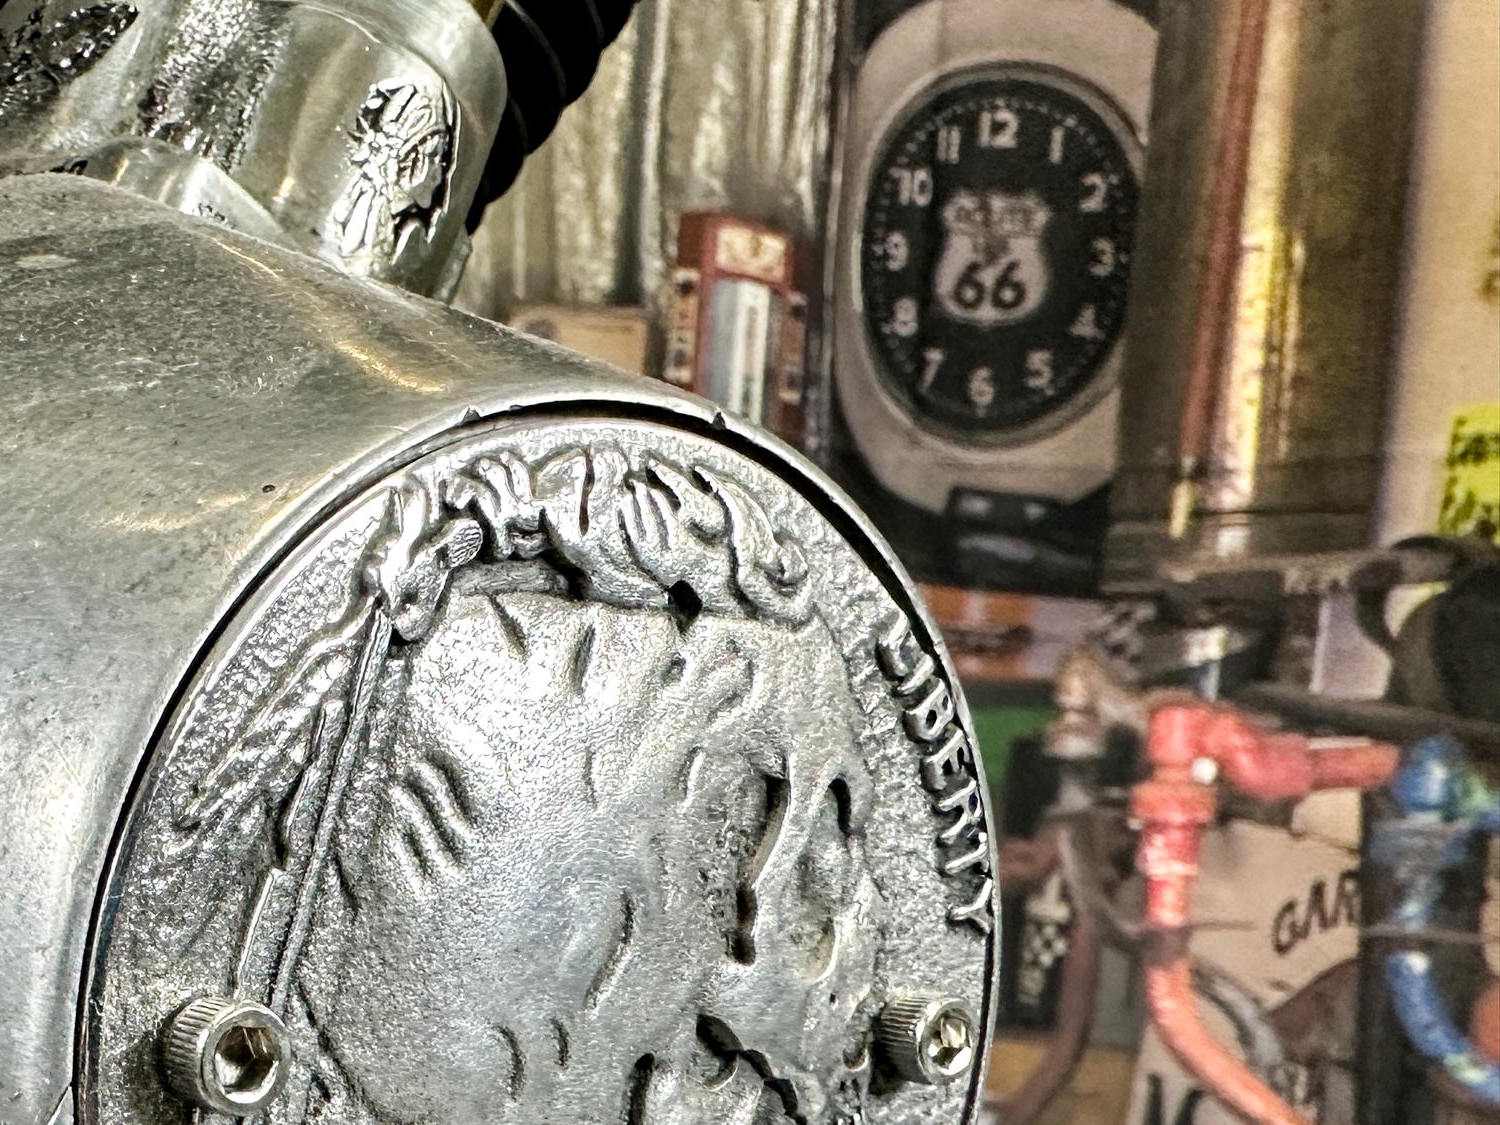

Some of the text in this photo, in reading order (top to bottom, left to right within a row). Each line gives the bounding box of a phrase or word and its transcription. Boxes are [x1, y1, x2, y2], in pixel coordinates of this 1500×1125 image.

[936, 124, 962, 165] 11
[978, 109, 1020, 149] 12
[1050, 125, 1065, 165] 1
[889, 166, 934, 208] 10
[1079, 172, 1108, 213] 2
[1090, 236, 1116, 277] 3
[954, 258, 1027, 312] 66
[877, 605, 994, 935] LIBERTY
